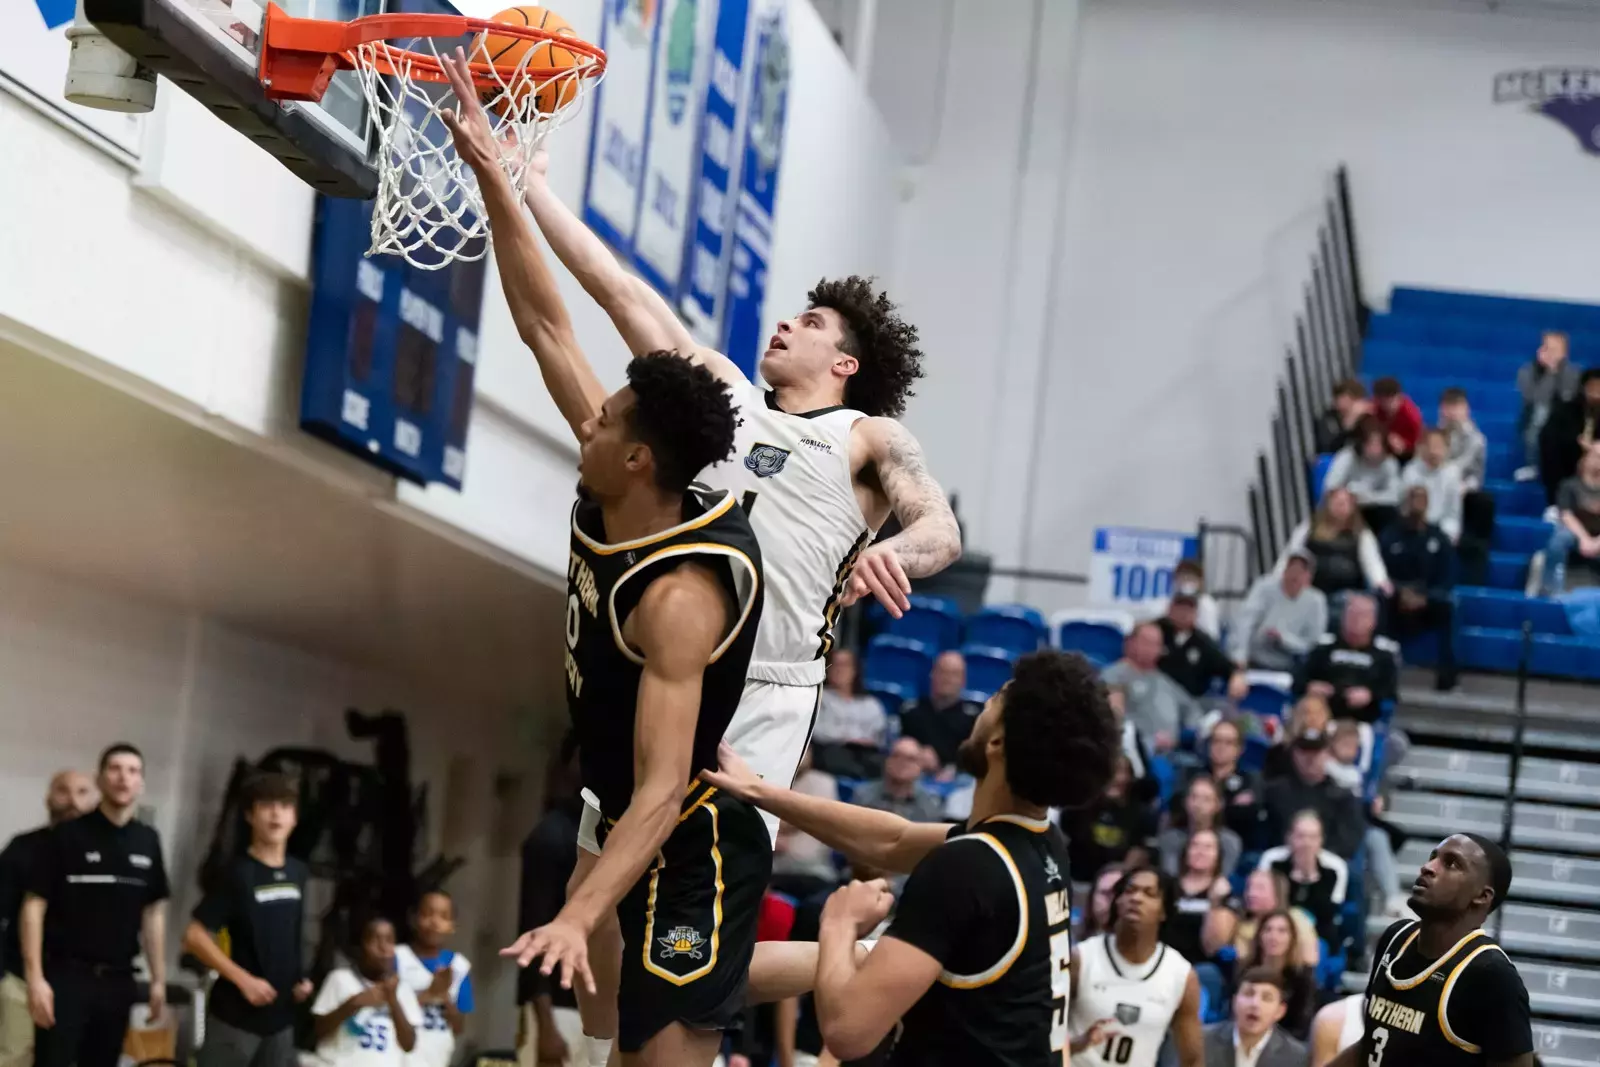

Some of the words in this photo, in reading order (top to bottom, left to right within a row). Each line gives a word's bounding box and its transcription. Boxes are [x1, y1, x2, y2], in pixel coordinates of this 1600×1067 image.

[800, 438, 831, 450] HORIZON
[668, 931, 700, 941] NORSE
[1102, 1036, 1133, 1064] 10
[1367, 1026, 1389, 1067] 3
